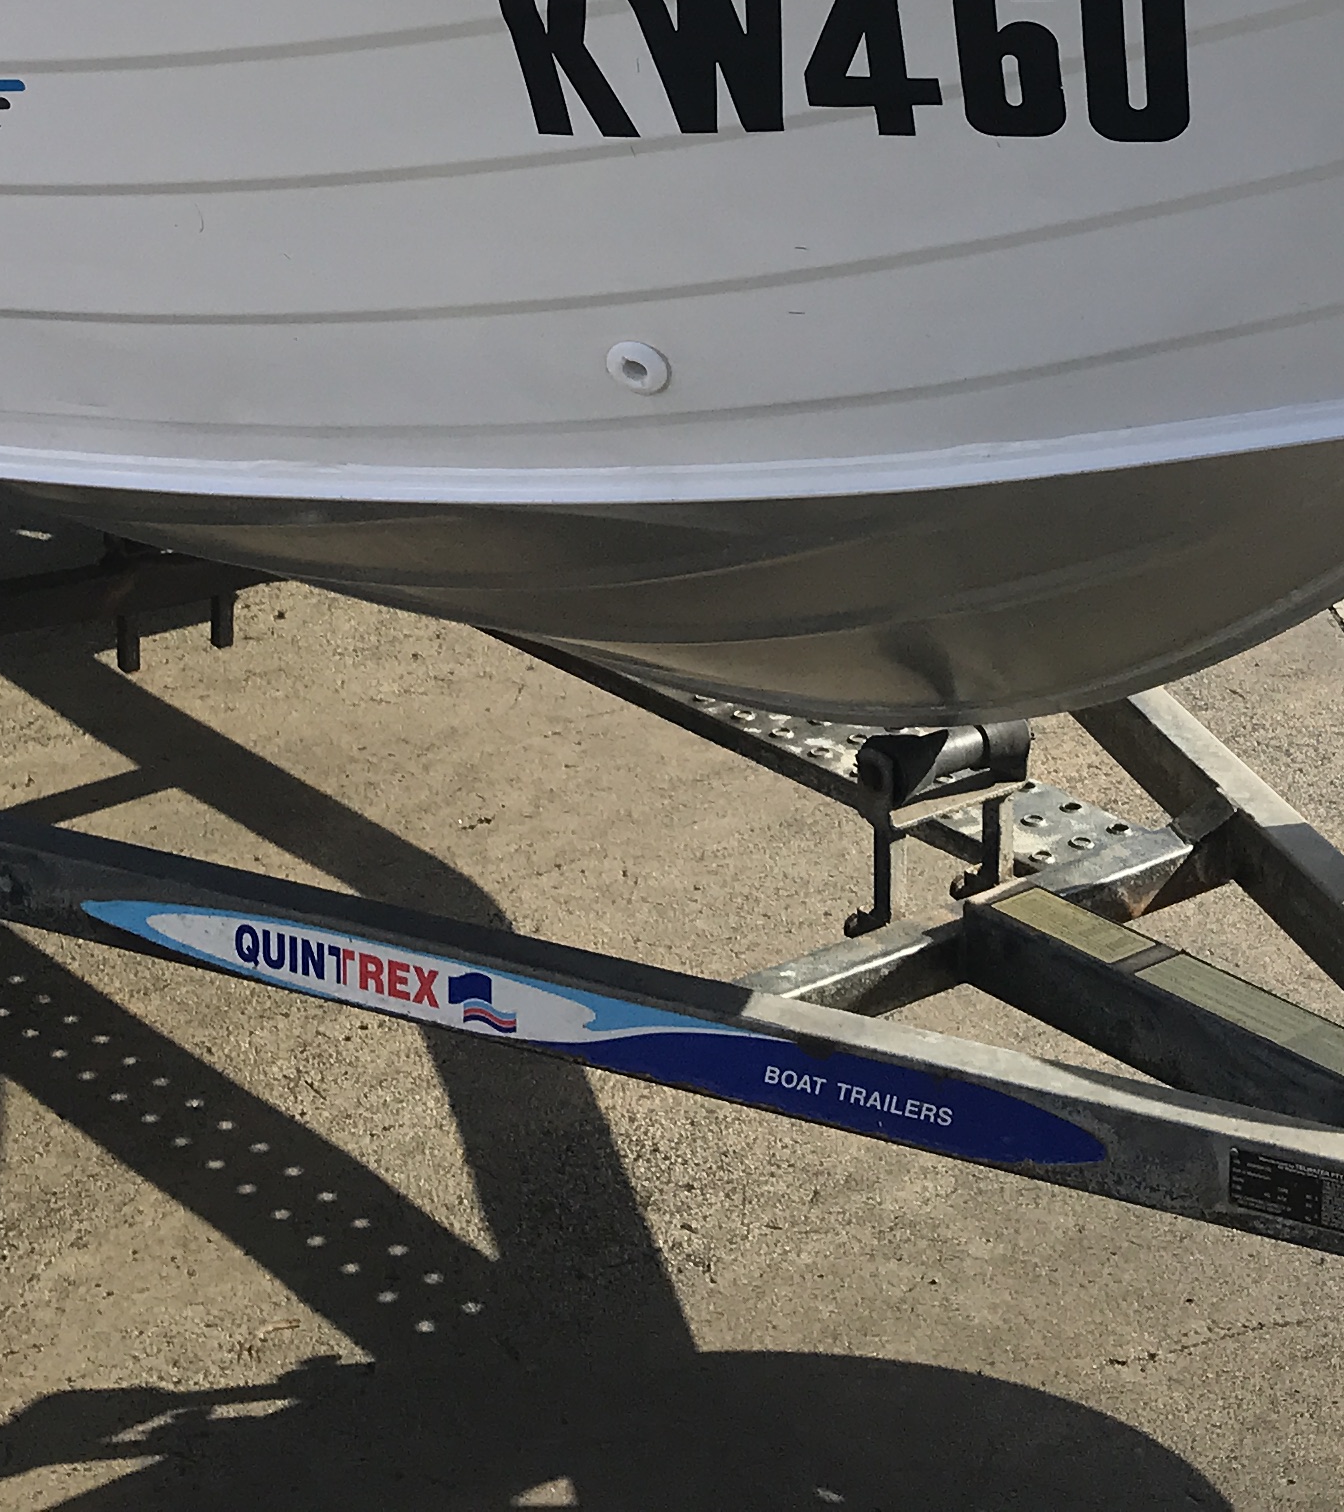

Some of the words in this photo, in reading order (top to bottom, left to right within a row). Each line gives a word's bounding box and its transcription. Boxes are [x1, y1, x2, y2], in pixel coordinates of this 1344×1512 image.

[235, 924, 440, 1009] QUINTREX
[764, 1065, 827, 1096] BOAT
[837, 1082, 954, 1127] TRAILERS
